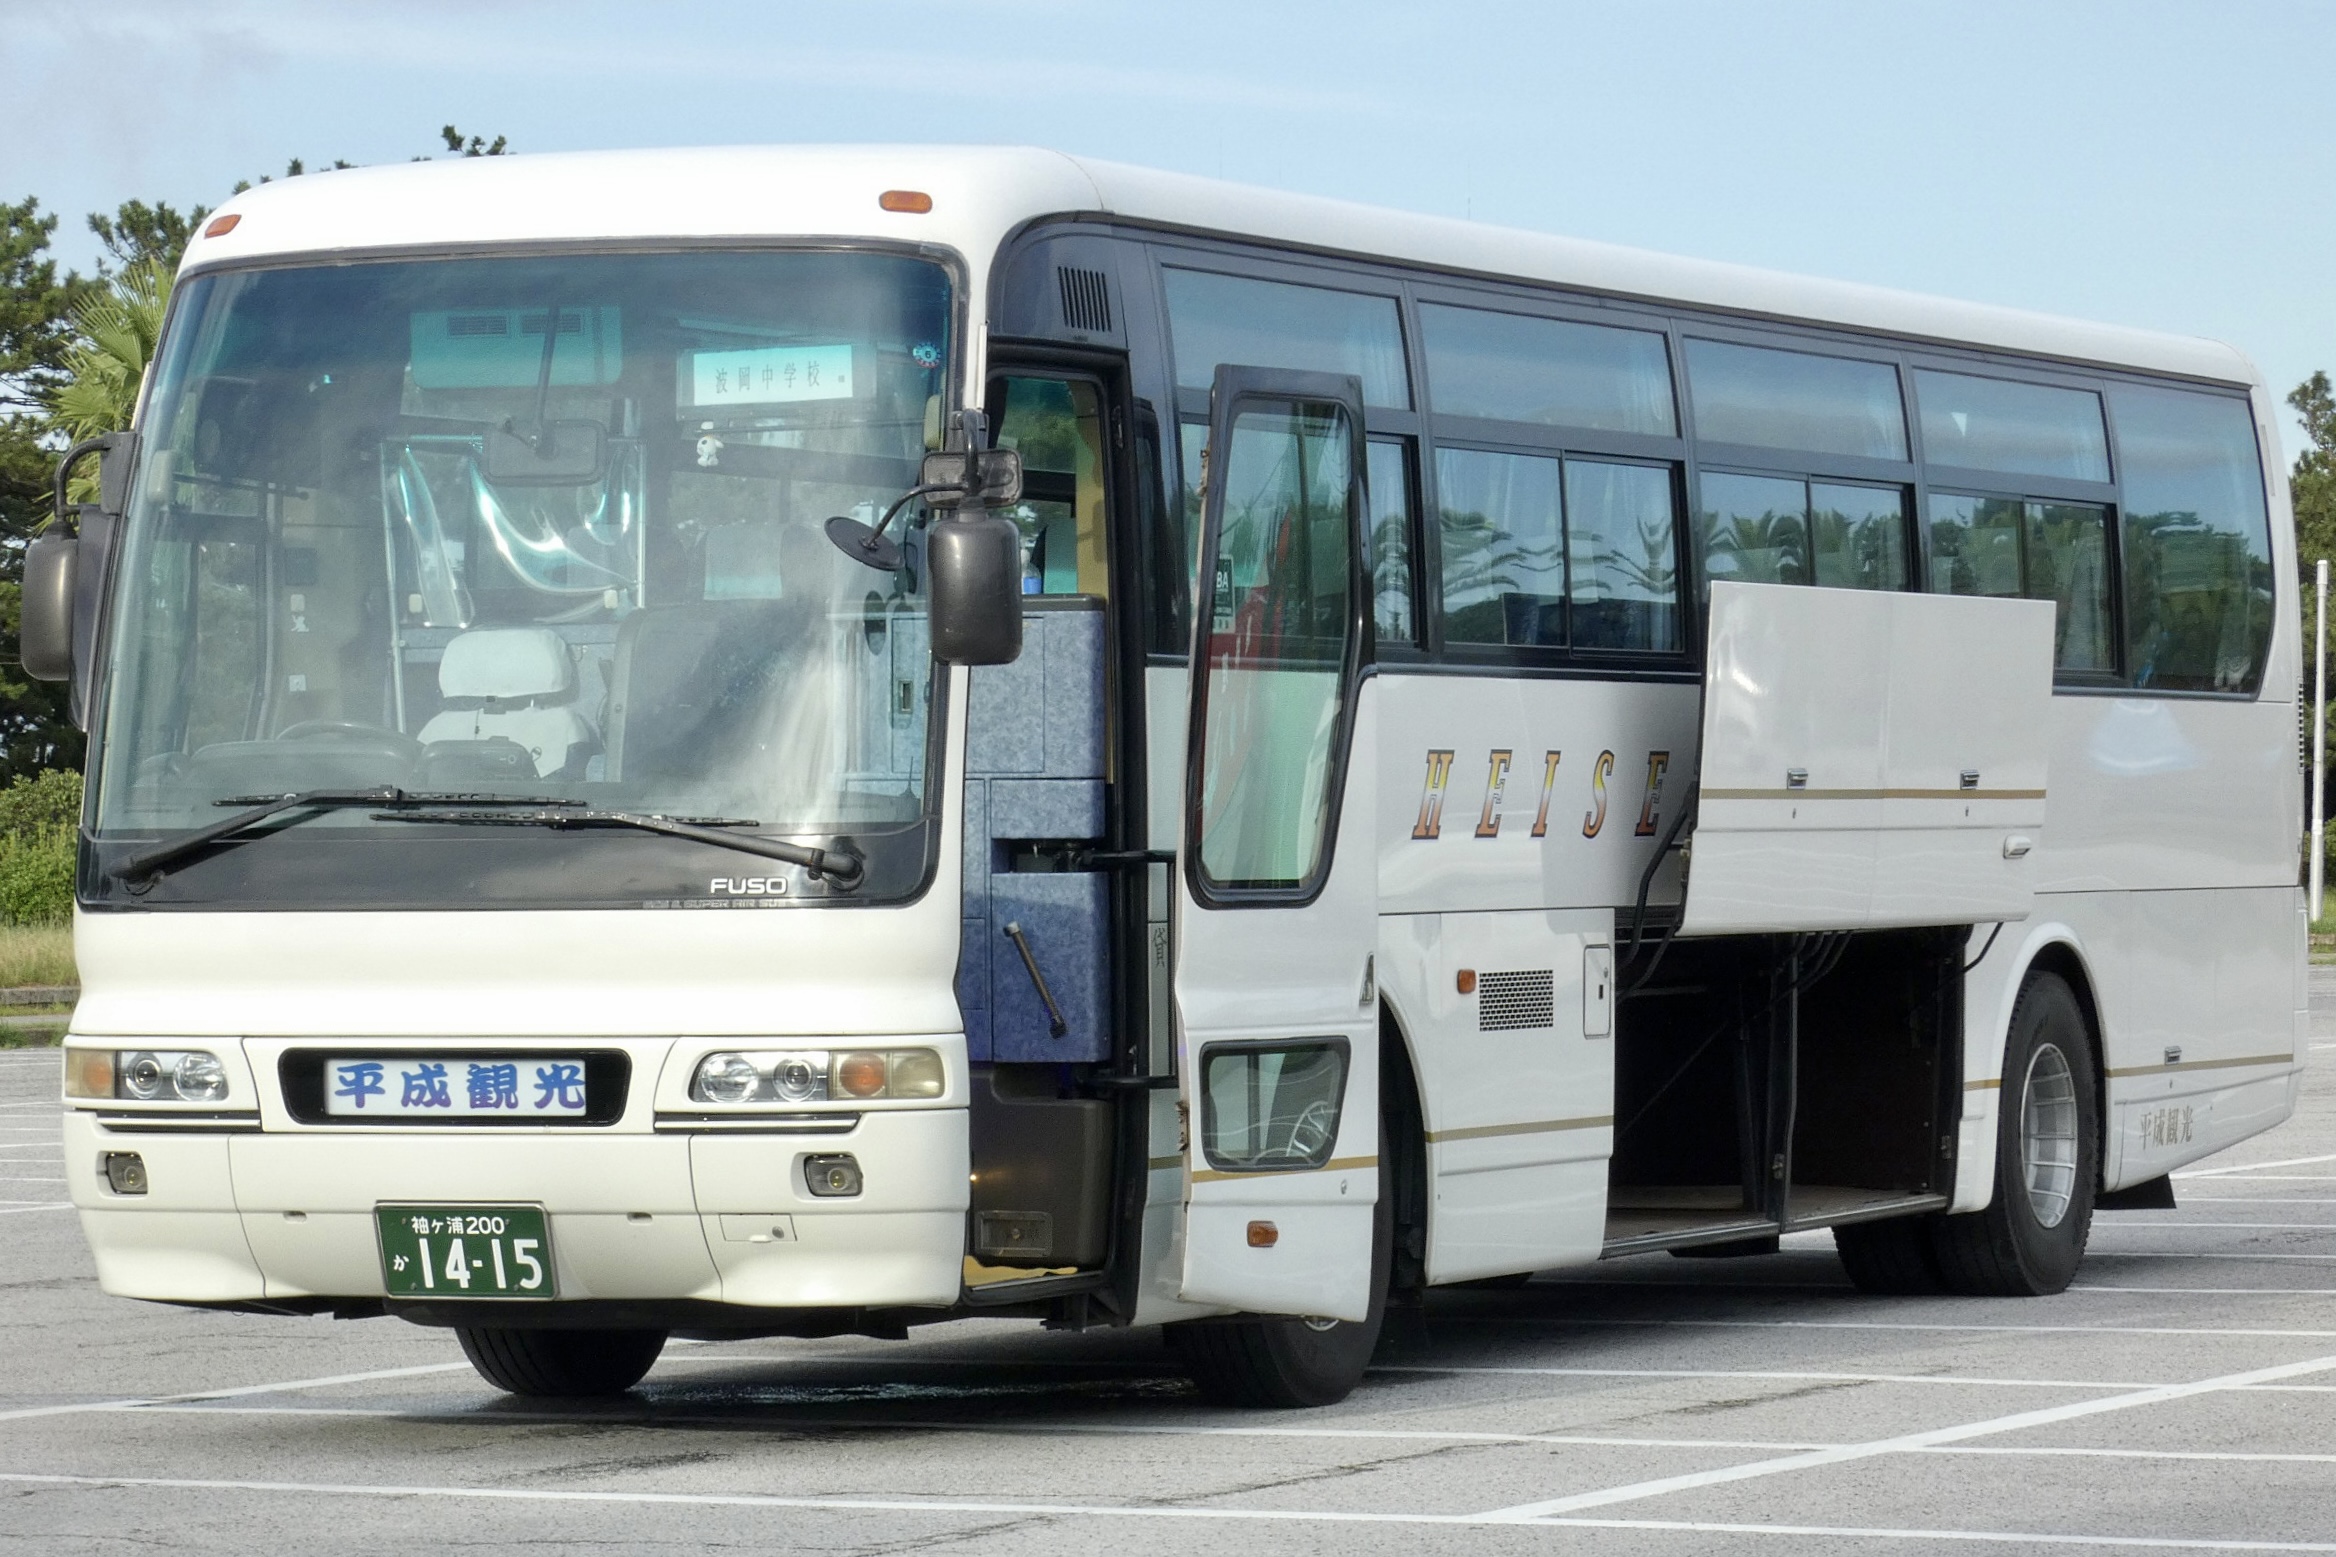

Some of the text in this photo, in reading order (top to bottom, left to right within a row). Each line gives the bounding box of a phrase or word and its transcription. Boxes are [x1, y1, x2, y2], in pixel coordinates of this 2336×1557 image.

[710, 877, 788, 895] FUSO
[334, 1062, 586, 1110] 平成観光
[393, 1238, 543, 1290] か 14-15
